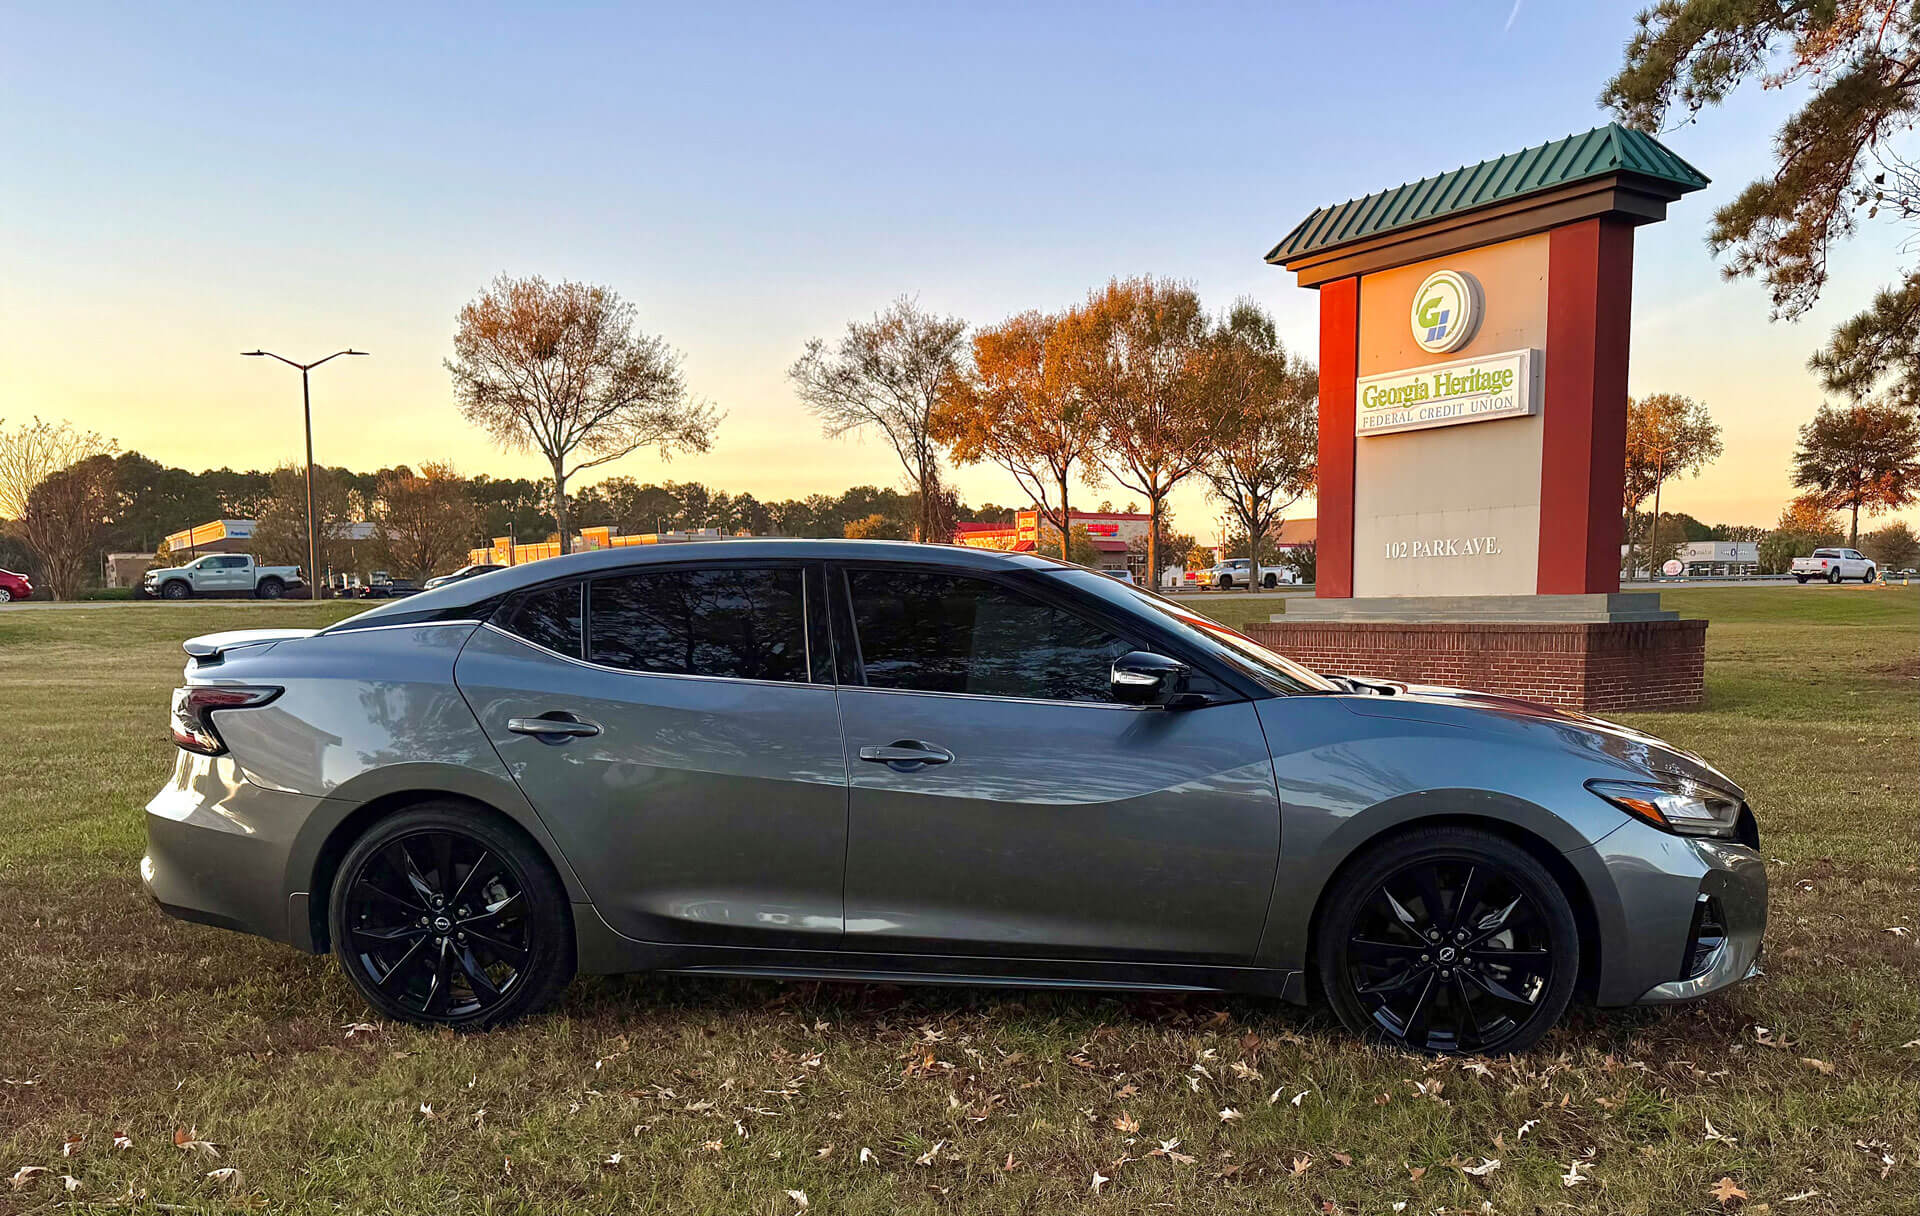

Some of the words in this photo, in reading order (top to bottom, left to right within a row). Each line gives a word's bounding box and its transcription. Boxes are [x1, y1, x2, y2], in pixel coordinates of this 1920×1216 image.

[1362, 377, 1429, 408] Georgia
[1433, 367, 1514, 395] Heritage
[1362, 411, 1414, 428] FEDERAL
[1419, 403, 1465, 420] CREDIT
[1471, 395, 1513, 413] UNION
[1385, 541, 1408, 559] 102
[1412, 537, 1460, 558] PARK
[1462, 536, 1502, 556] AVE.
